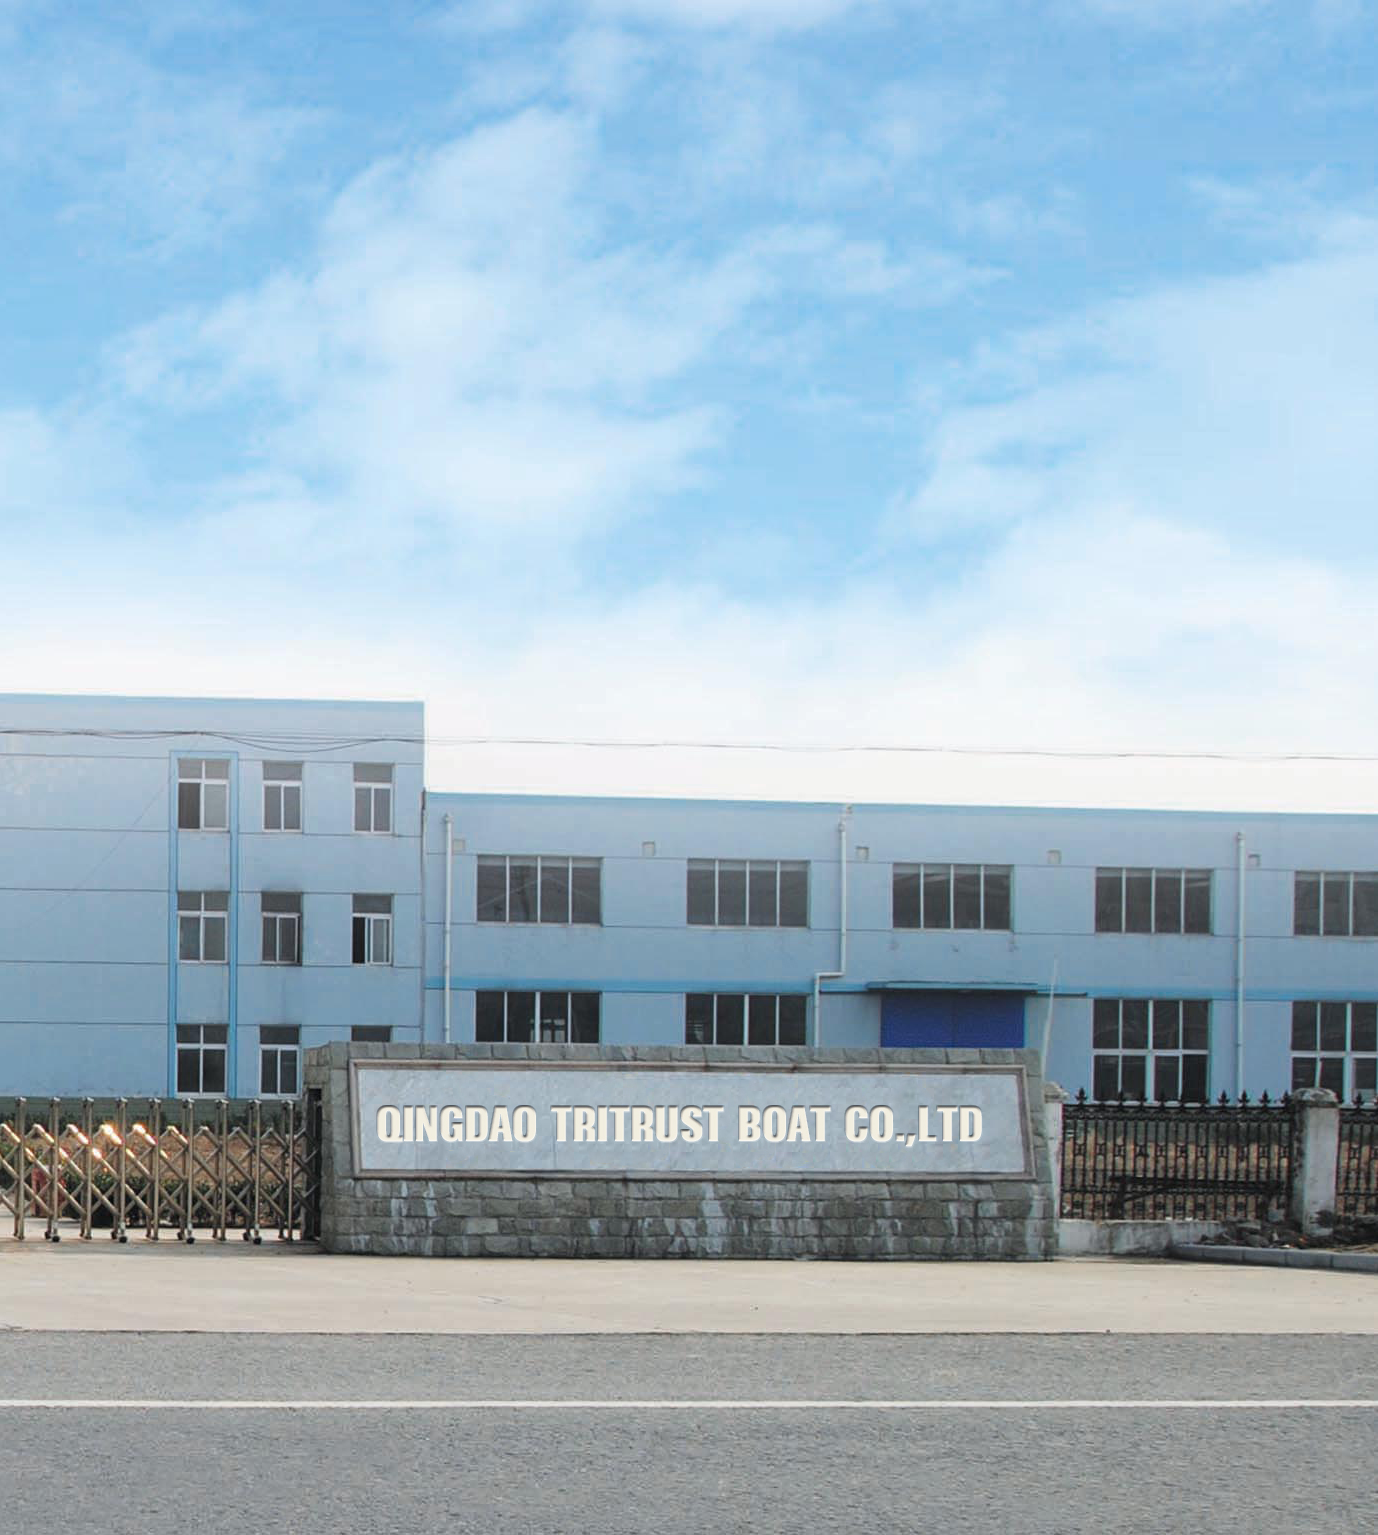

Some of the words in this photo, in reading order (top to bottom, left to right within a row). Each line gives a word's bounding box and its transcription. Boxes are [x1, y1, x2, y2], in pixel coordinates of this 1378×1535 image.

[376, 1105, 537, 1143] QINGDAO
[550, 1105, 724, 1142] TRITRUST
[738, 1105, 831, 1142] BOAT
[845, 1105, 983, 1147] CO.,LTD
